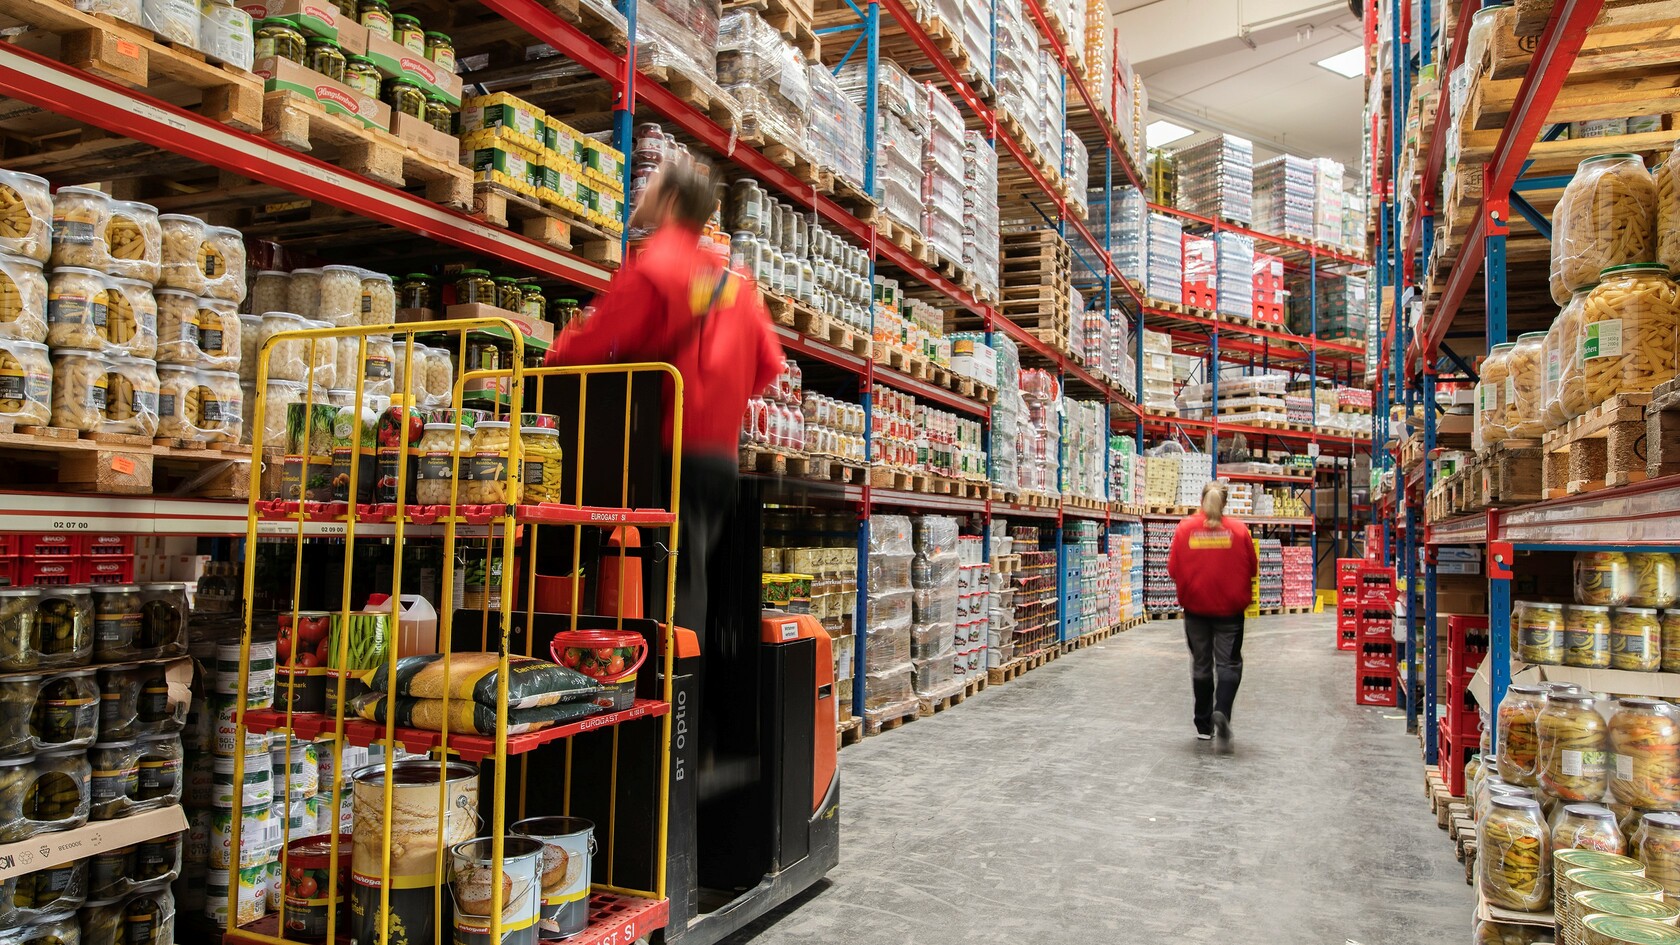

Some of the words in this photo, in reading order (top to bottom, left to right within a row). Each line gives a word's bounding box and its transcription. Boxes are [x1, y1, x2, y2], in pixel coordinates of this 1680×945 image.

[317, 87, 358, 111] Hengstenberg
[590, 513, 618, 521] EUROGAST
[580, 714, 619, 730] EUROGAST
[675, 690, 688, 749] optio
[676, 757, 685, 781] BT
[624, 923, 635, 942] SI
